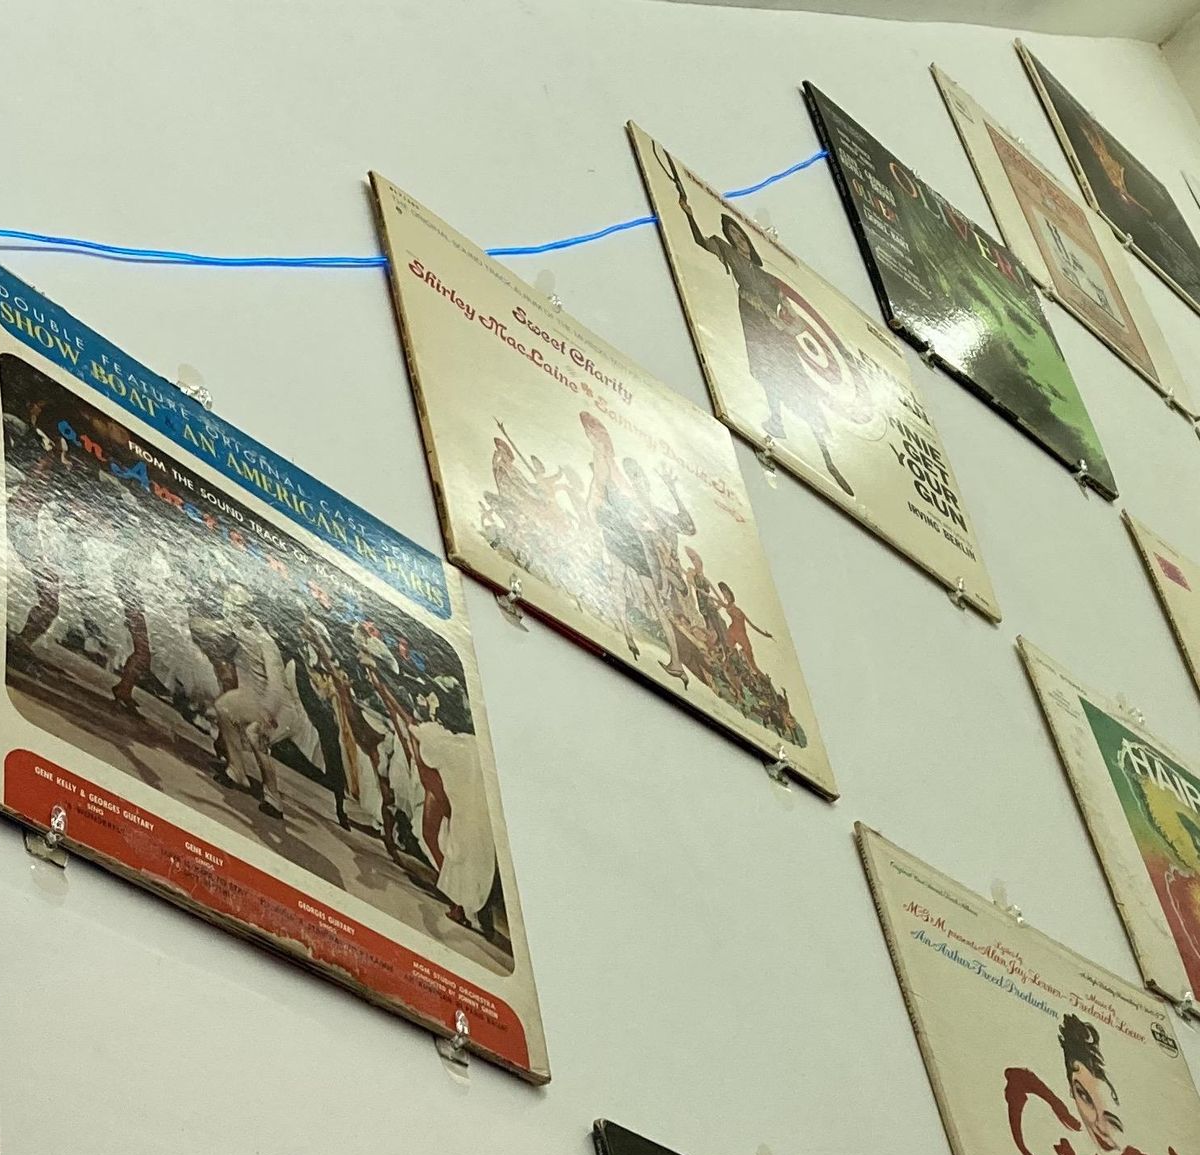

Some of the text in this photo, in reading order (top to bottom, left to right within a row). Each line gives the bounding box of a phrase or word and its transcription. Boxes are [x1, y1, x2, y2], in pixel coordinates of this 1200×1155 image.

[408, 259, 476, 321] Shirley
[511, 306, 633, 405] Sweet Charity
[0, 300, 445, 608] SHOW BOAT AN AMERICAN PARIS
[101, 353, 190, 421] FEATURE
[204, 424, 312, 498] ORIGINAL
[320, 500, 366, 536] CAST
[903, 440, 949, 487] GET
[128, 440, 167, 472] FROM
[171, 468, 194, 491] THE
[200, 488, 244, 523] SOUND
[249, 520, 288, 551] TRACK
[889, 442, 959, 511] YOUR
[914, 480, 968, 532] GUN
[908, 501, 940, 534] IRVING
[944, 528, 977, 562] BERLIN
[34, 766, 54, 782] GENE
[56, 776, 77, 794] KELLY
[89, 792, 120, 815] GEORGES
[184, 841, 224, 868] GENE KELLY
[297, 900, 326, 921] GEORGES
[459, 983, 497, 1010] ORCHESTRA
[931, 943, 971, 970] Arthur
[971, 960, 1006, 988] Freed
[1001, 978, 1059, 1020] Production
